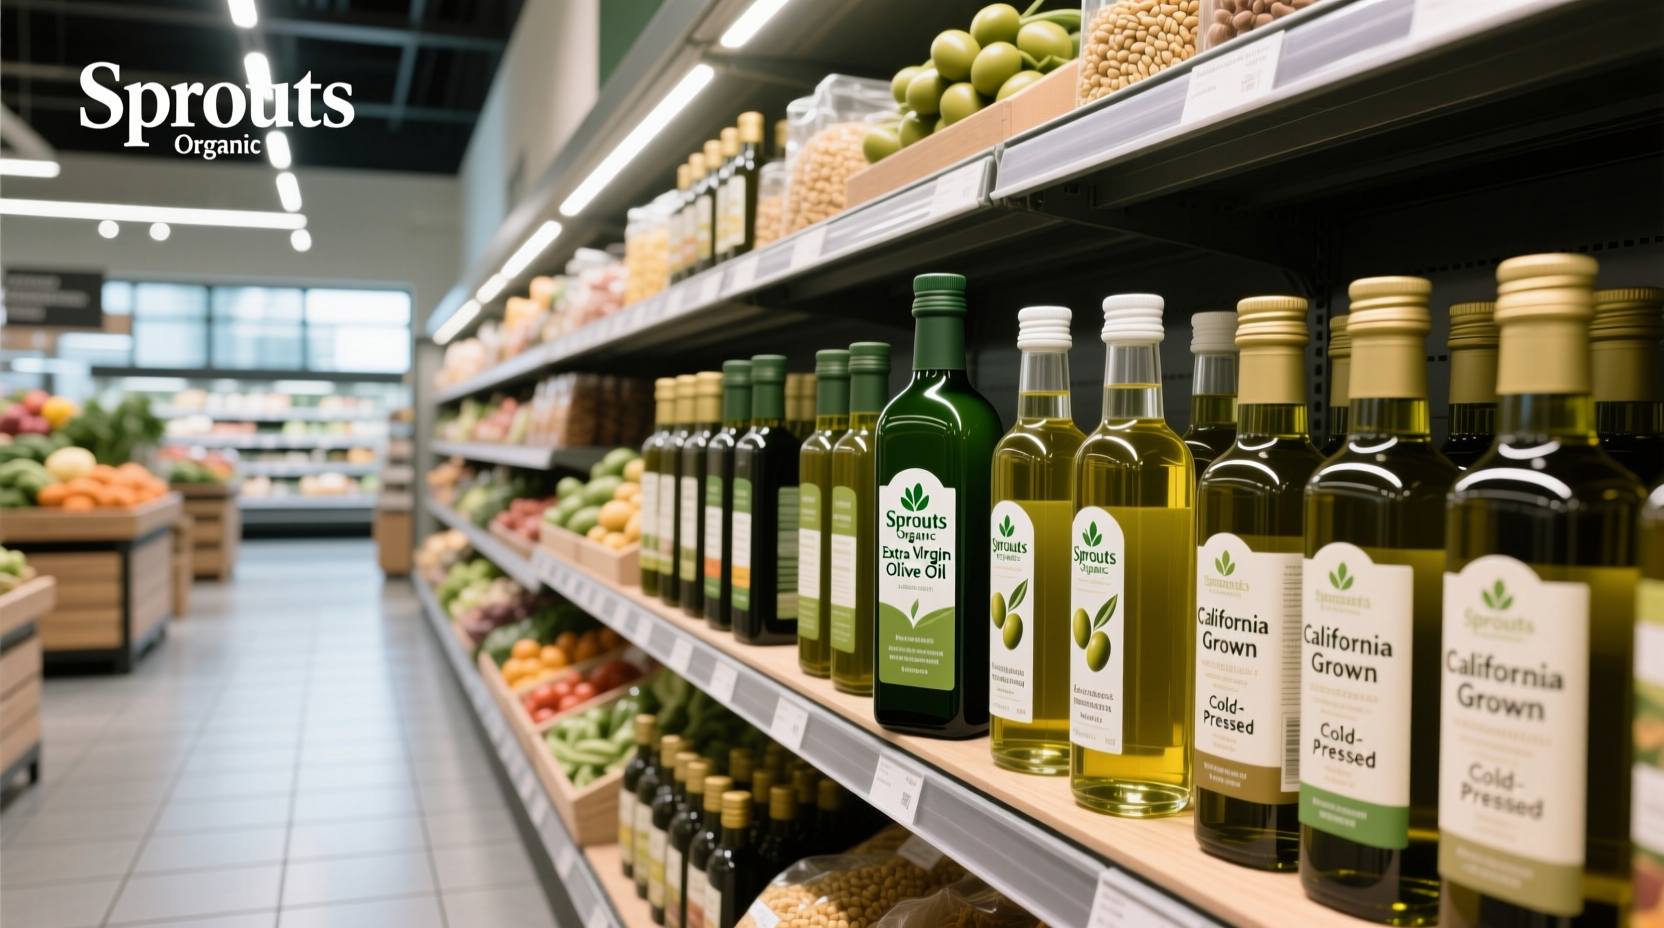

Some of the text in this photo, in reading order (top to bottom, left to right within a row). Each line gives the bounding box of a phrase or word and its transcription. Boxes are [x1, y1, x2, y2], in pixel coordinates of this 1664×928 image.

[886, 510, 947, 532] Sprouts
[882, 545, 951, 565] Extra Virgin
[1073, 545, 1117, 566] Sprouts
[886, 561, 946, 580] Olive Oil
[1197, 606, 1269, 635] California
[1202, 630, 1257, 658] Grown
[1303, 623, 1393, 658] California
[1311, 652, 1377, 683] Grown
[1446, 649, 1565, 692] California
[1209, 694, 1245, 715] Cold-
[1457, 682, 1545, 721] Grown
[1203, 709, 1254, 736] Pressed
[1320, 721, 1363, 746] Cold-
[1312, 738, 1376, 769] Pressed
[1468, 762, 1525, 792] Cold-
[1461, 780, 1545, 821] Pressed
